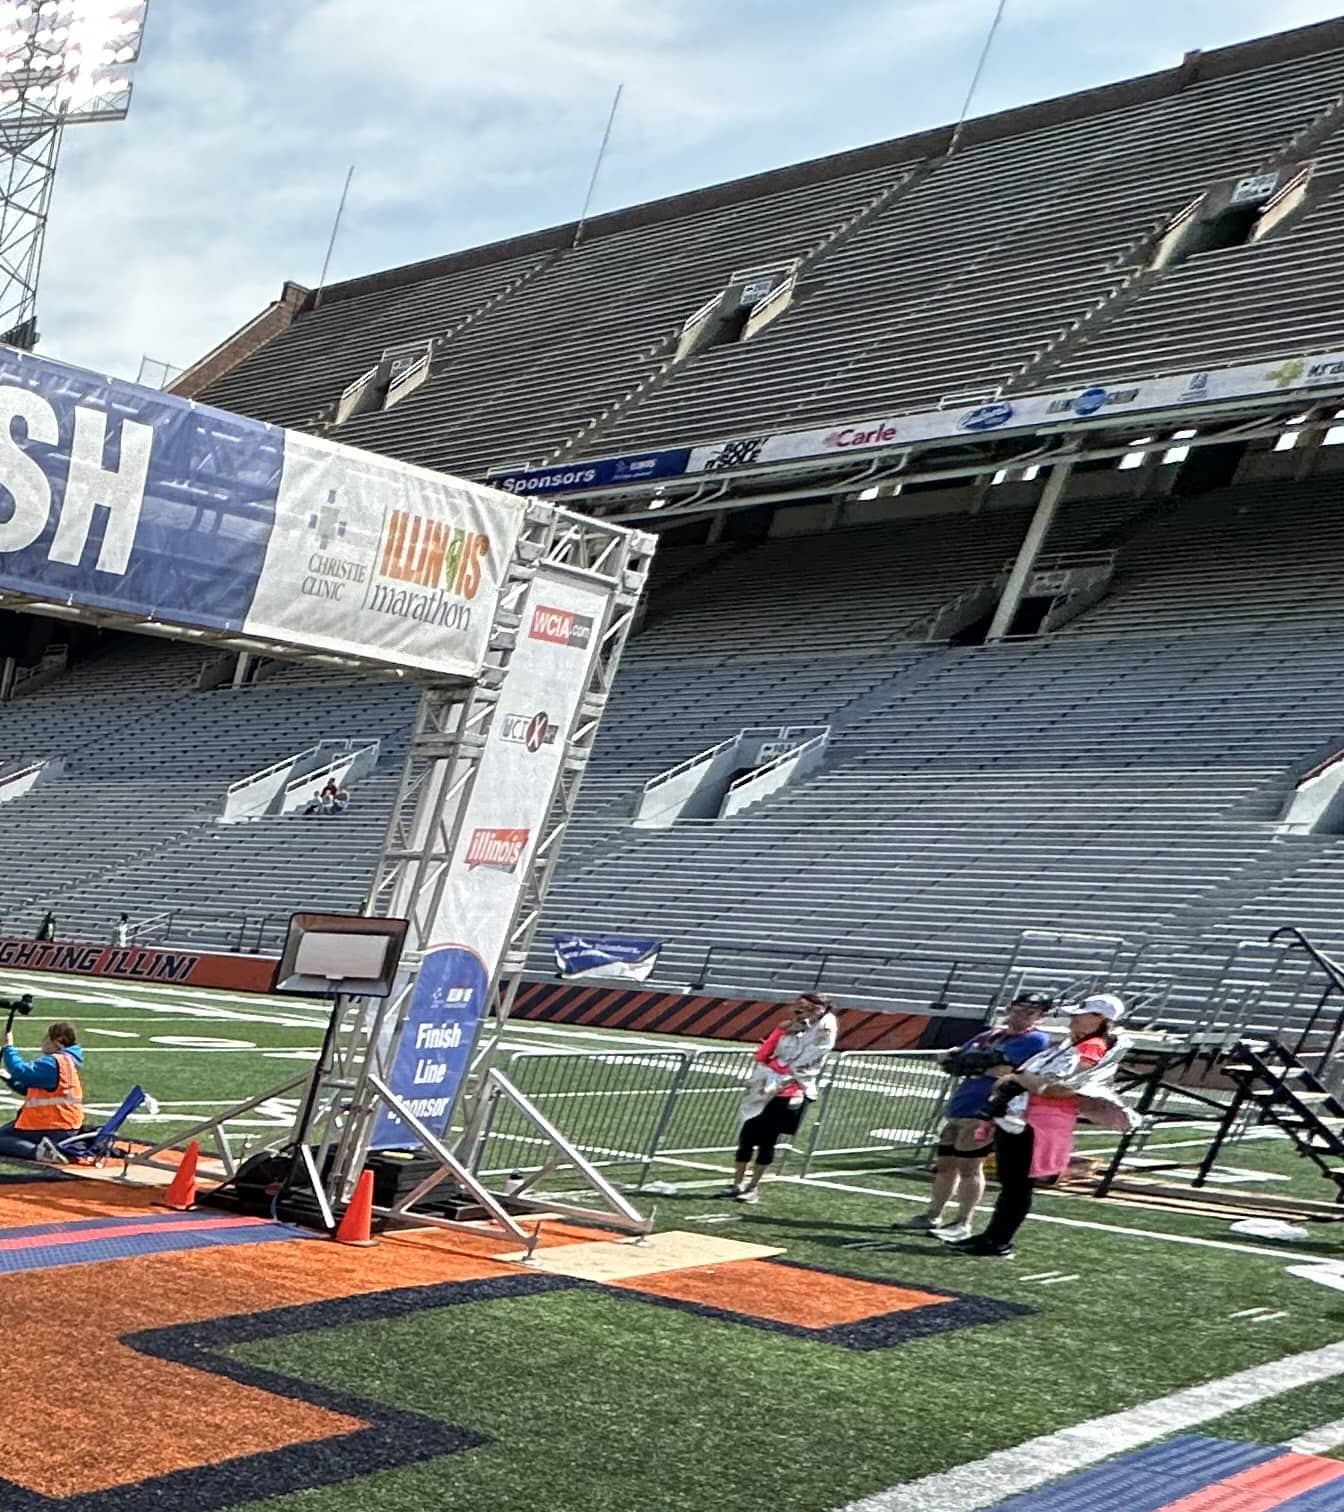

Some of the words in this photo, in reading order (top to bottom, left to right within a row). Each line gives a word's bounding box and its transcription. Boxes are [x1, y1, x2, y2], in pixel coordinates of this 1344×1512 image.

[835, 423, 897, 447] Carle
[502, 467, 596, 494] Sponsors
[308, 552, 368, 584] CHRISTIE
[301, 576, 345, 602] CLINIC
[368, 584, 472, 632] marathon
[533, 610, 591, 639] WCIA.com
[468, 831, 522, 864] illinois
[103, 948, 200, 981] ILLINI
[415, 1023, 462, 1049] Finish
[413, 1058, 448, 1085] Line
